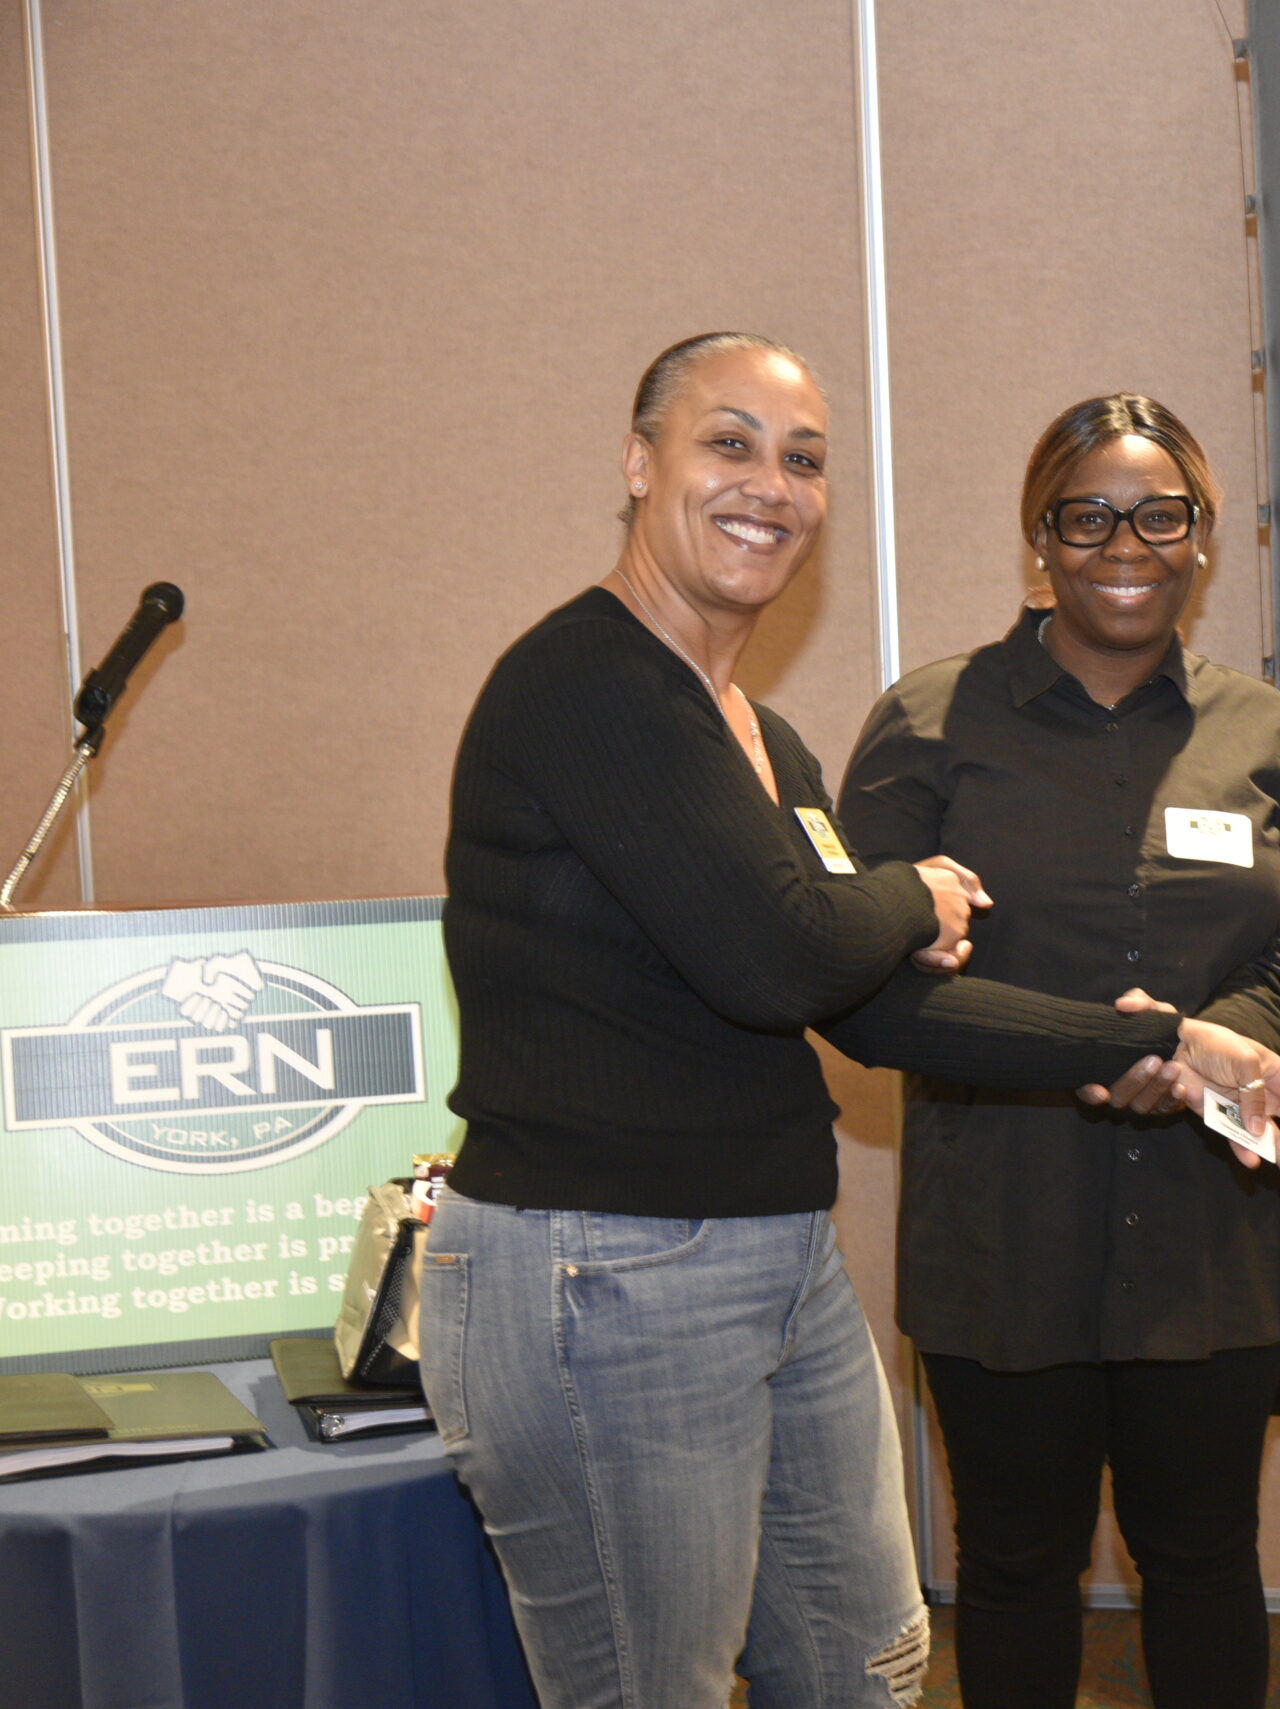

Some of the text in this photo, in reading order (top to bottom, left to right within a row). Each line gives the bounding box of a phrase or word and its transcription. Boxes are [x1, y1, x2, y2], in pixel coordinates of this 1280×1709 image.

[110, 1028, 336, 1105] ERN
[151, 1115, 295, 1148] YORK, PA
[88, 1203, 235, 1240] together
[245, 1199, 275, 1224] is
[285, 1201, 305, 1220] a
[121, 1239, 268, 1275] together
[278, 1233, 308, 1259] is
[0, 1270, 349, 1320] orking together is s
